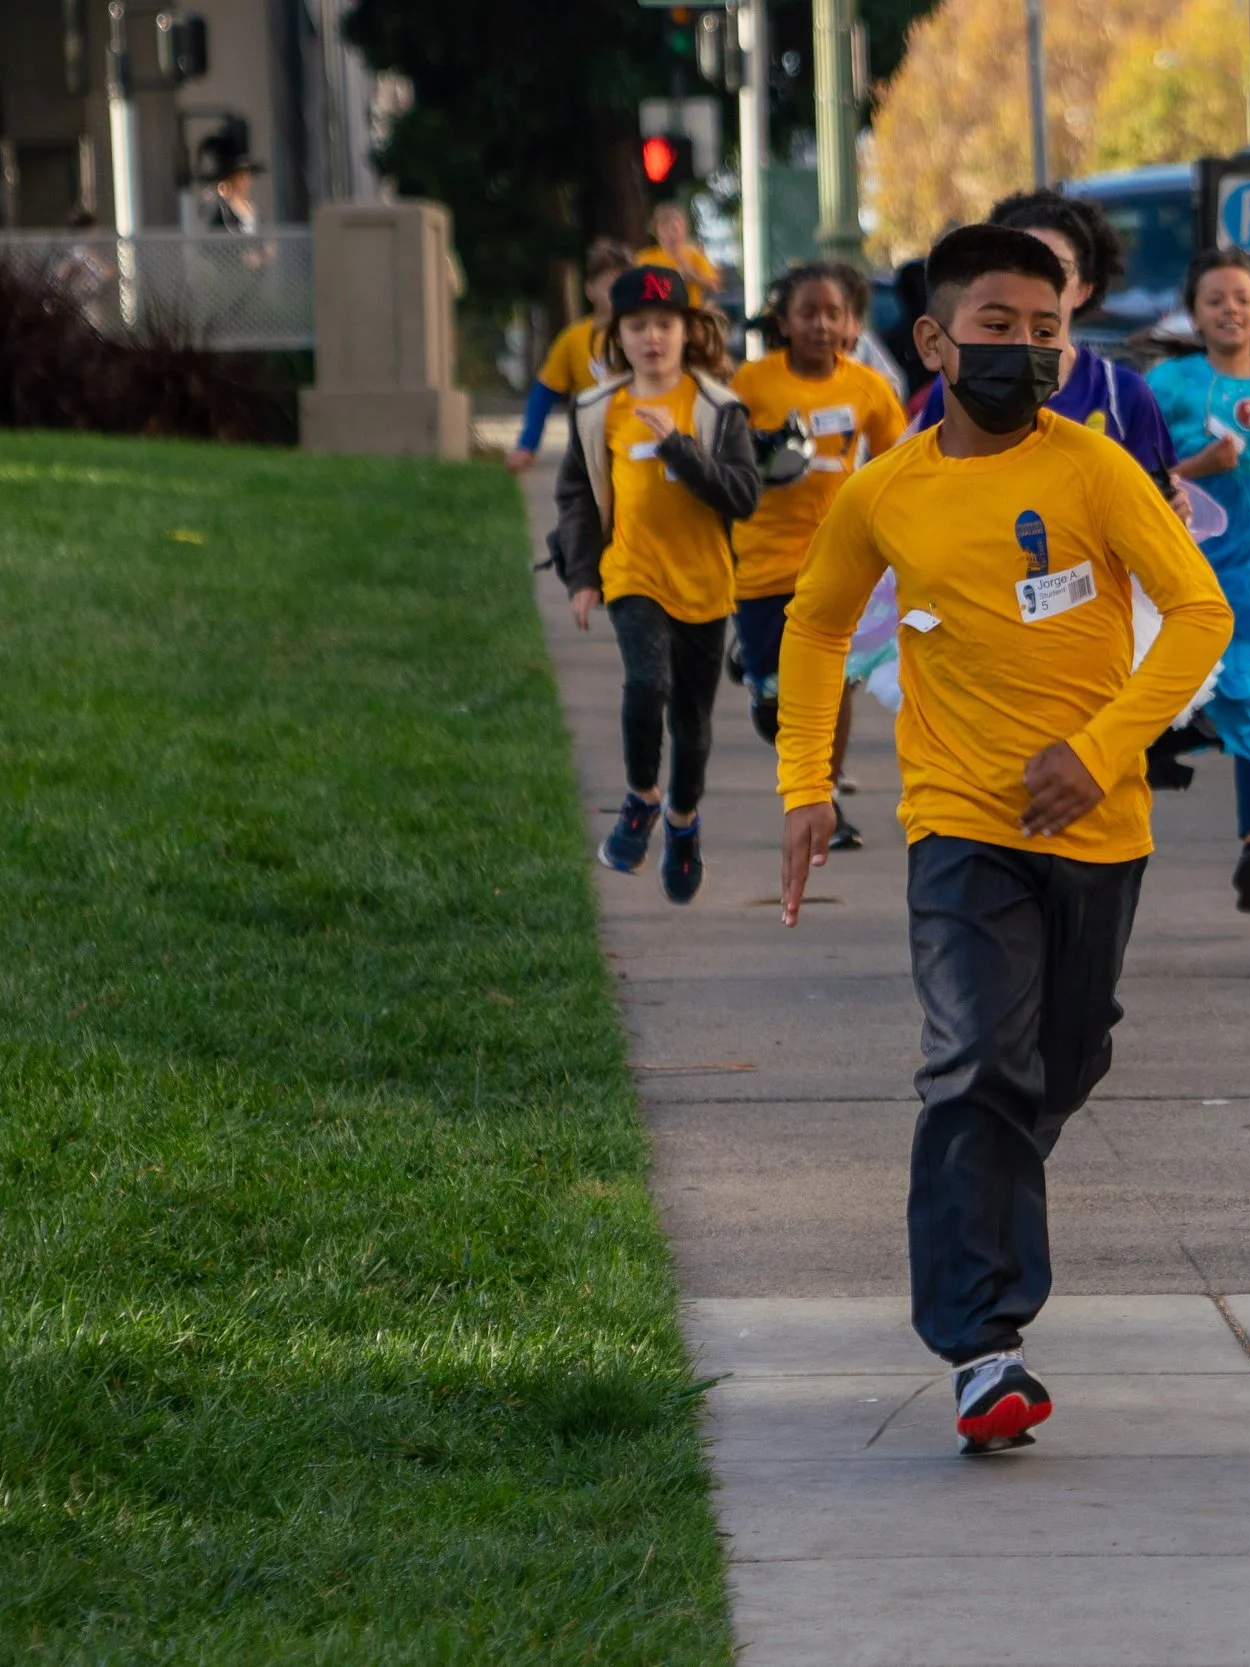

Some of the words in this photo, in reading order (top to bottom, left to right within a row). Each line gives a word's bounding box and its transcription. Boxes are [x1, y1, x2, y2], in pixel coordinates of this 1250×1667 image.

[1037, 575, 1067, 590] Jorge
[1069, 570, 1079, 581] A.
[1038, 587, 1066, 600] Student
[1041, 600, 1049, 611] 5
